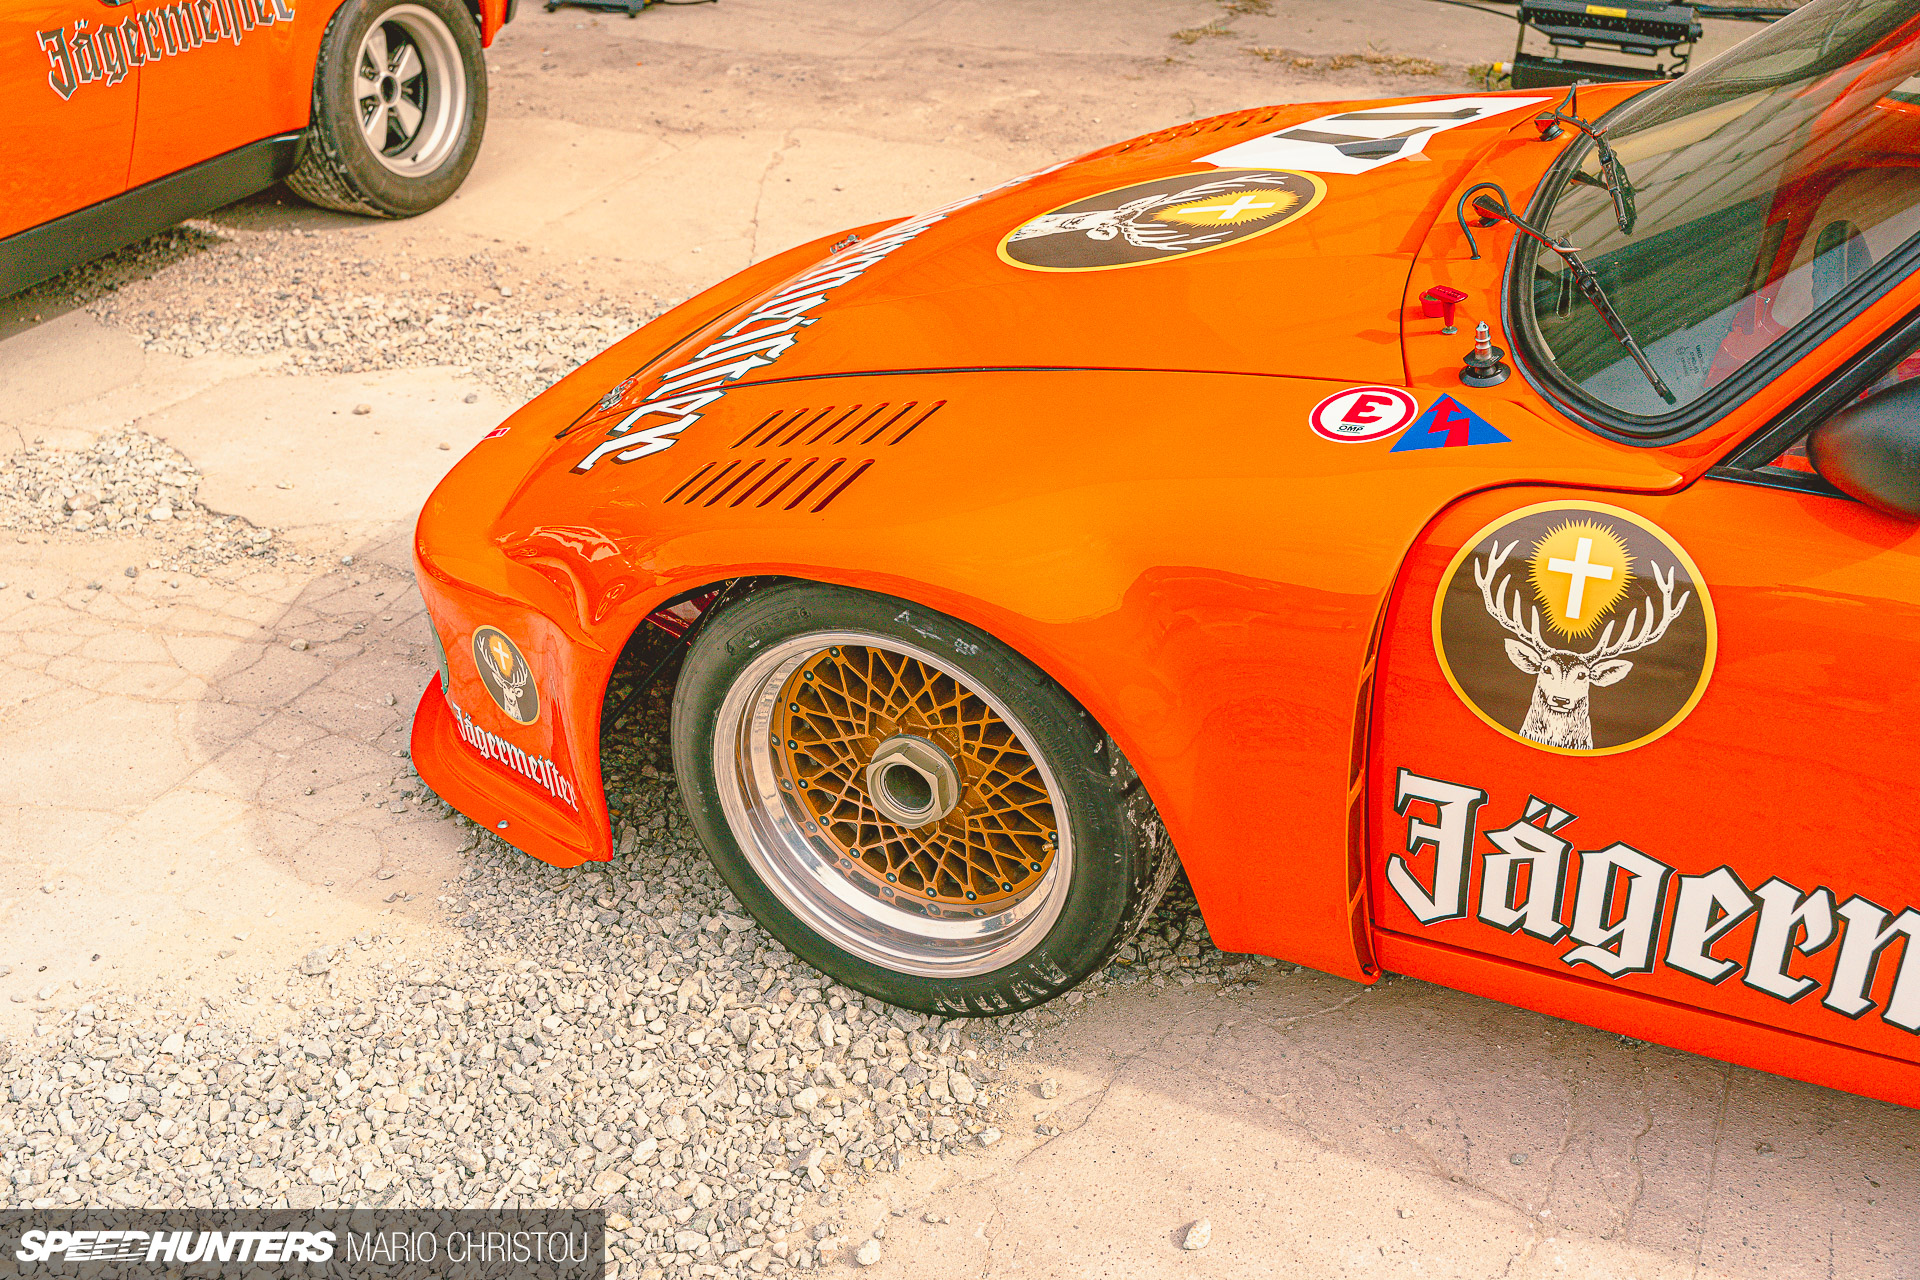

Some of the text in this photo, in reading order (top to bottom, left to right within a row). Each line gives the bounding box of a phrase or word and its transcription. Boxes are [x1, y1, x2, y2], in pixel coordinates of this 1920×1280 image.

[1340, 393, 1394, 424] E
[1337, 424, 1366, 434] OMP
[451, 701, 580, 813] Jägermeister
